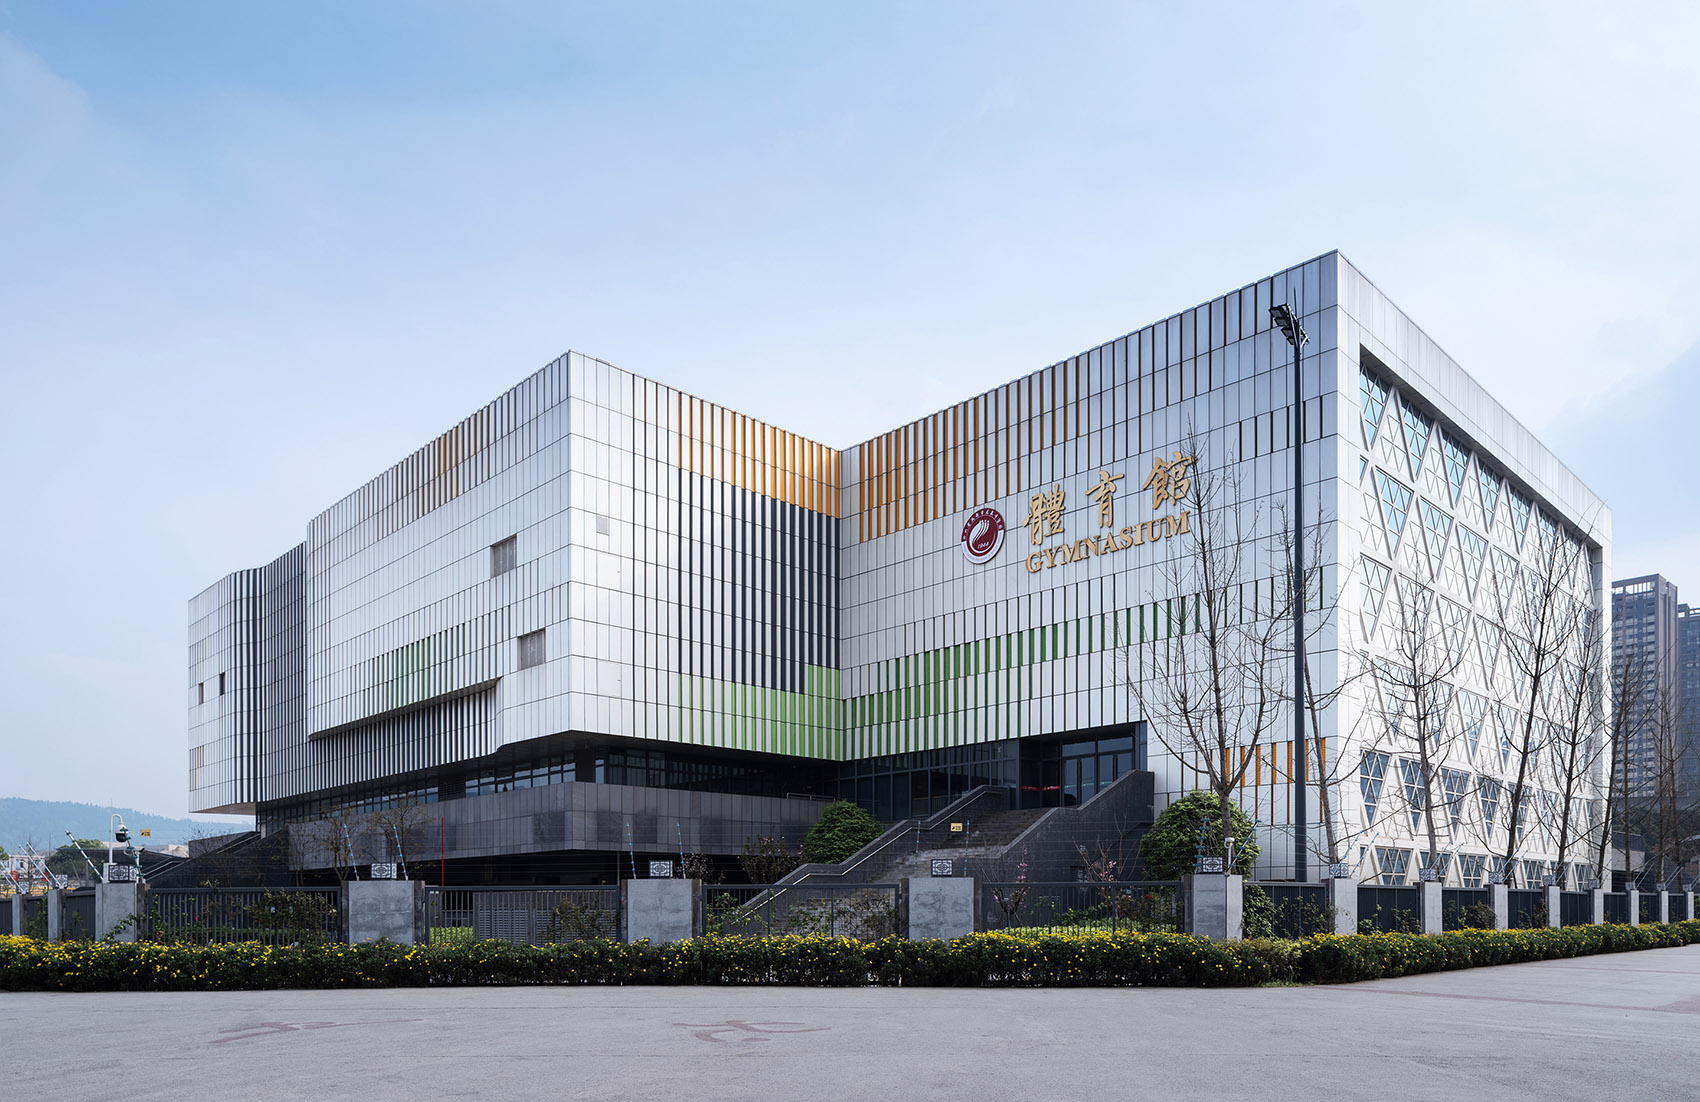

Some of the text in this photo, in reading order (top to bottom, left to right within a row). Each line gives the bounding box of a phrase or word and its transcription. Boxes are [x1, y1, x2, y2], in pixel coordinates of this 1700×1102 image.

[1022, 451, 1198, 546] 體育館
[1025, 510, 1191, 574] GYMNASIUM
